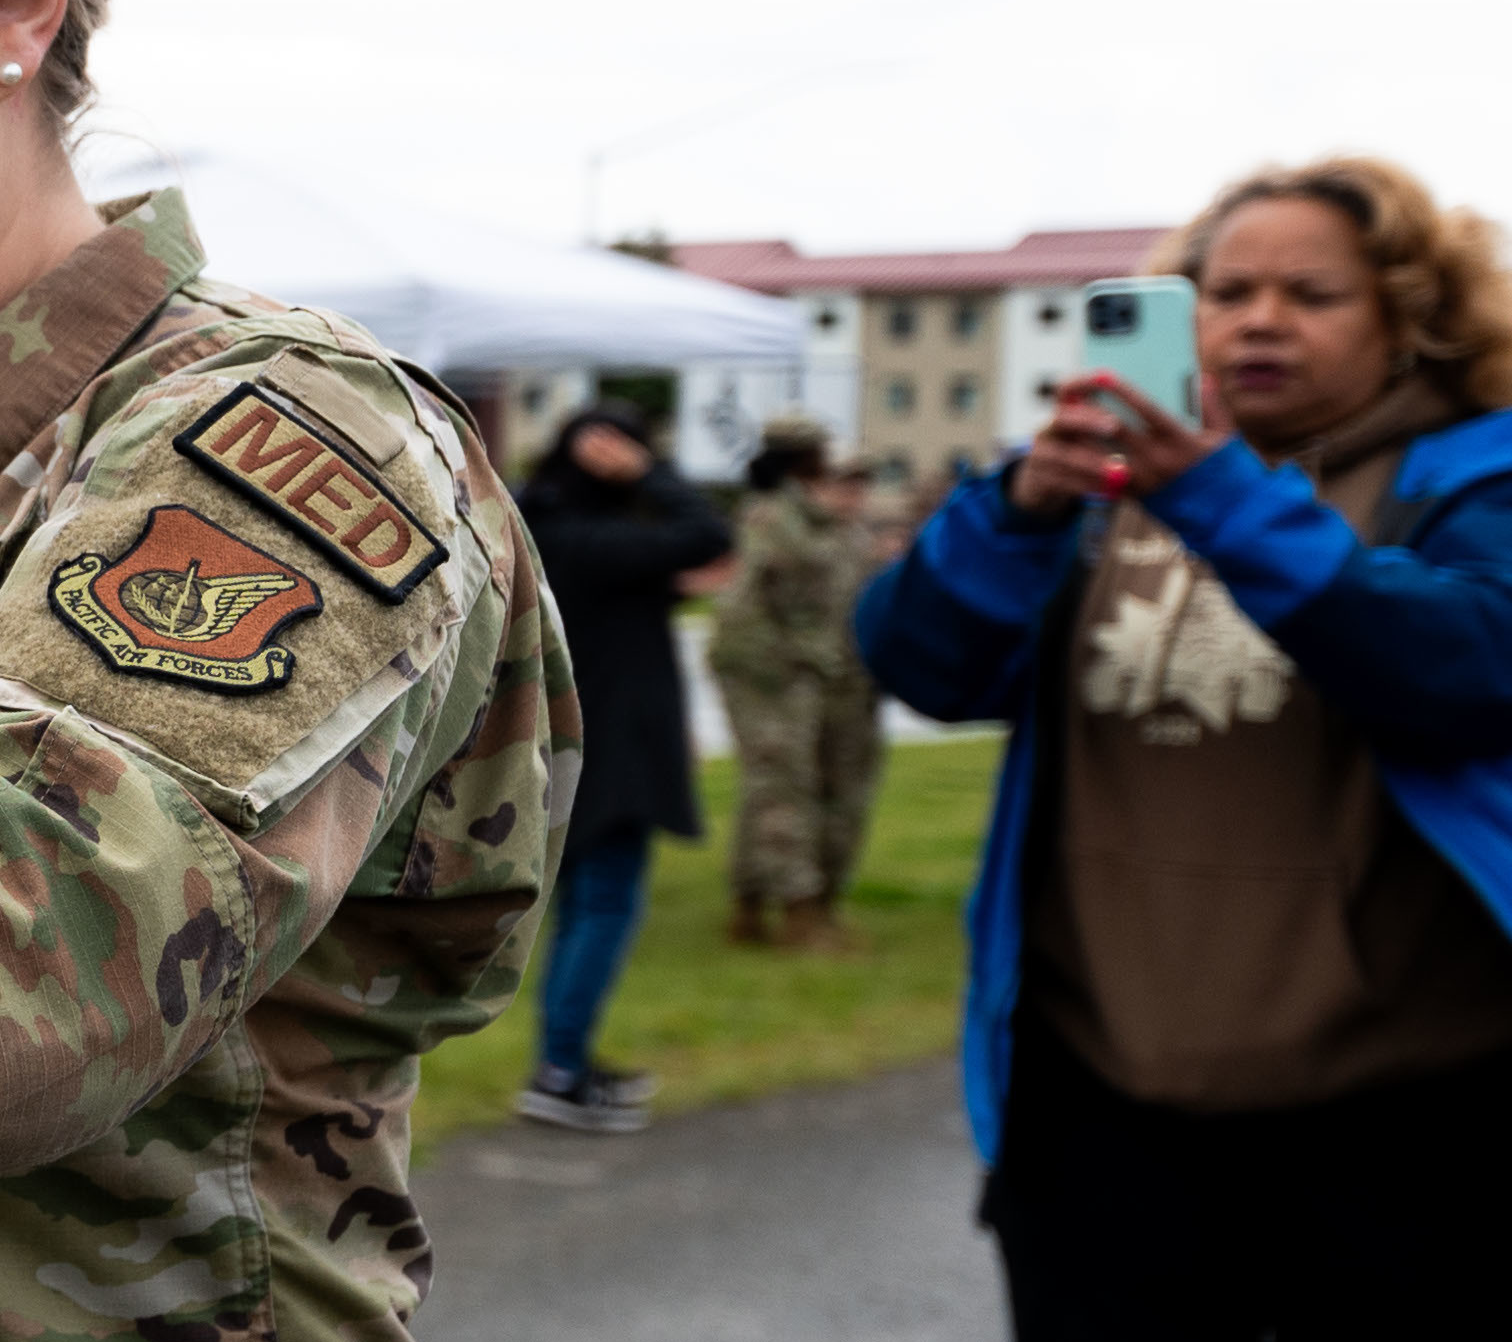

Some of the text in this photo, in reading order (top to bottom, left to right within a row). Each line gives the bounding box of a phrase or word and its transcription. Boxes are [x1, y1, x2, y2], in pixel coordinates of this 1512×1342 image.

[210, 405, 412, 568] MED
[60, 586, 255, 683] PACIFIC AIR FORCES
